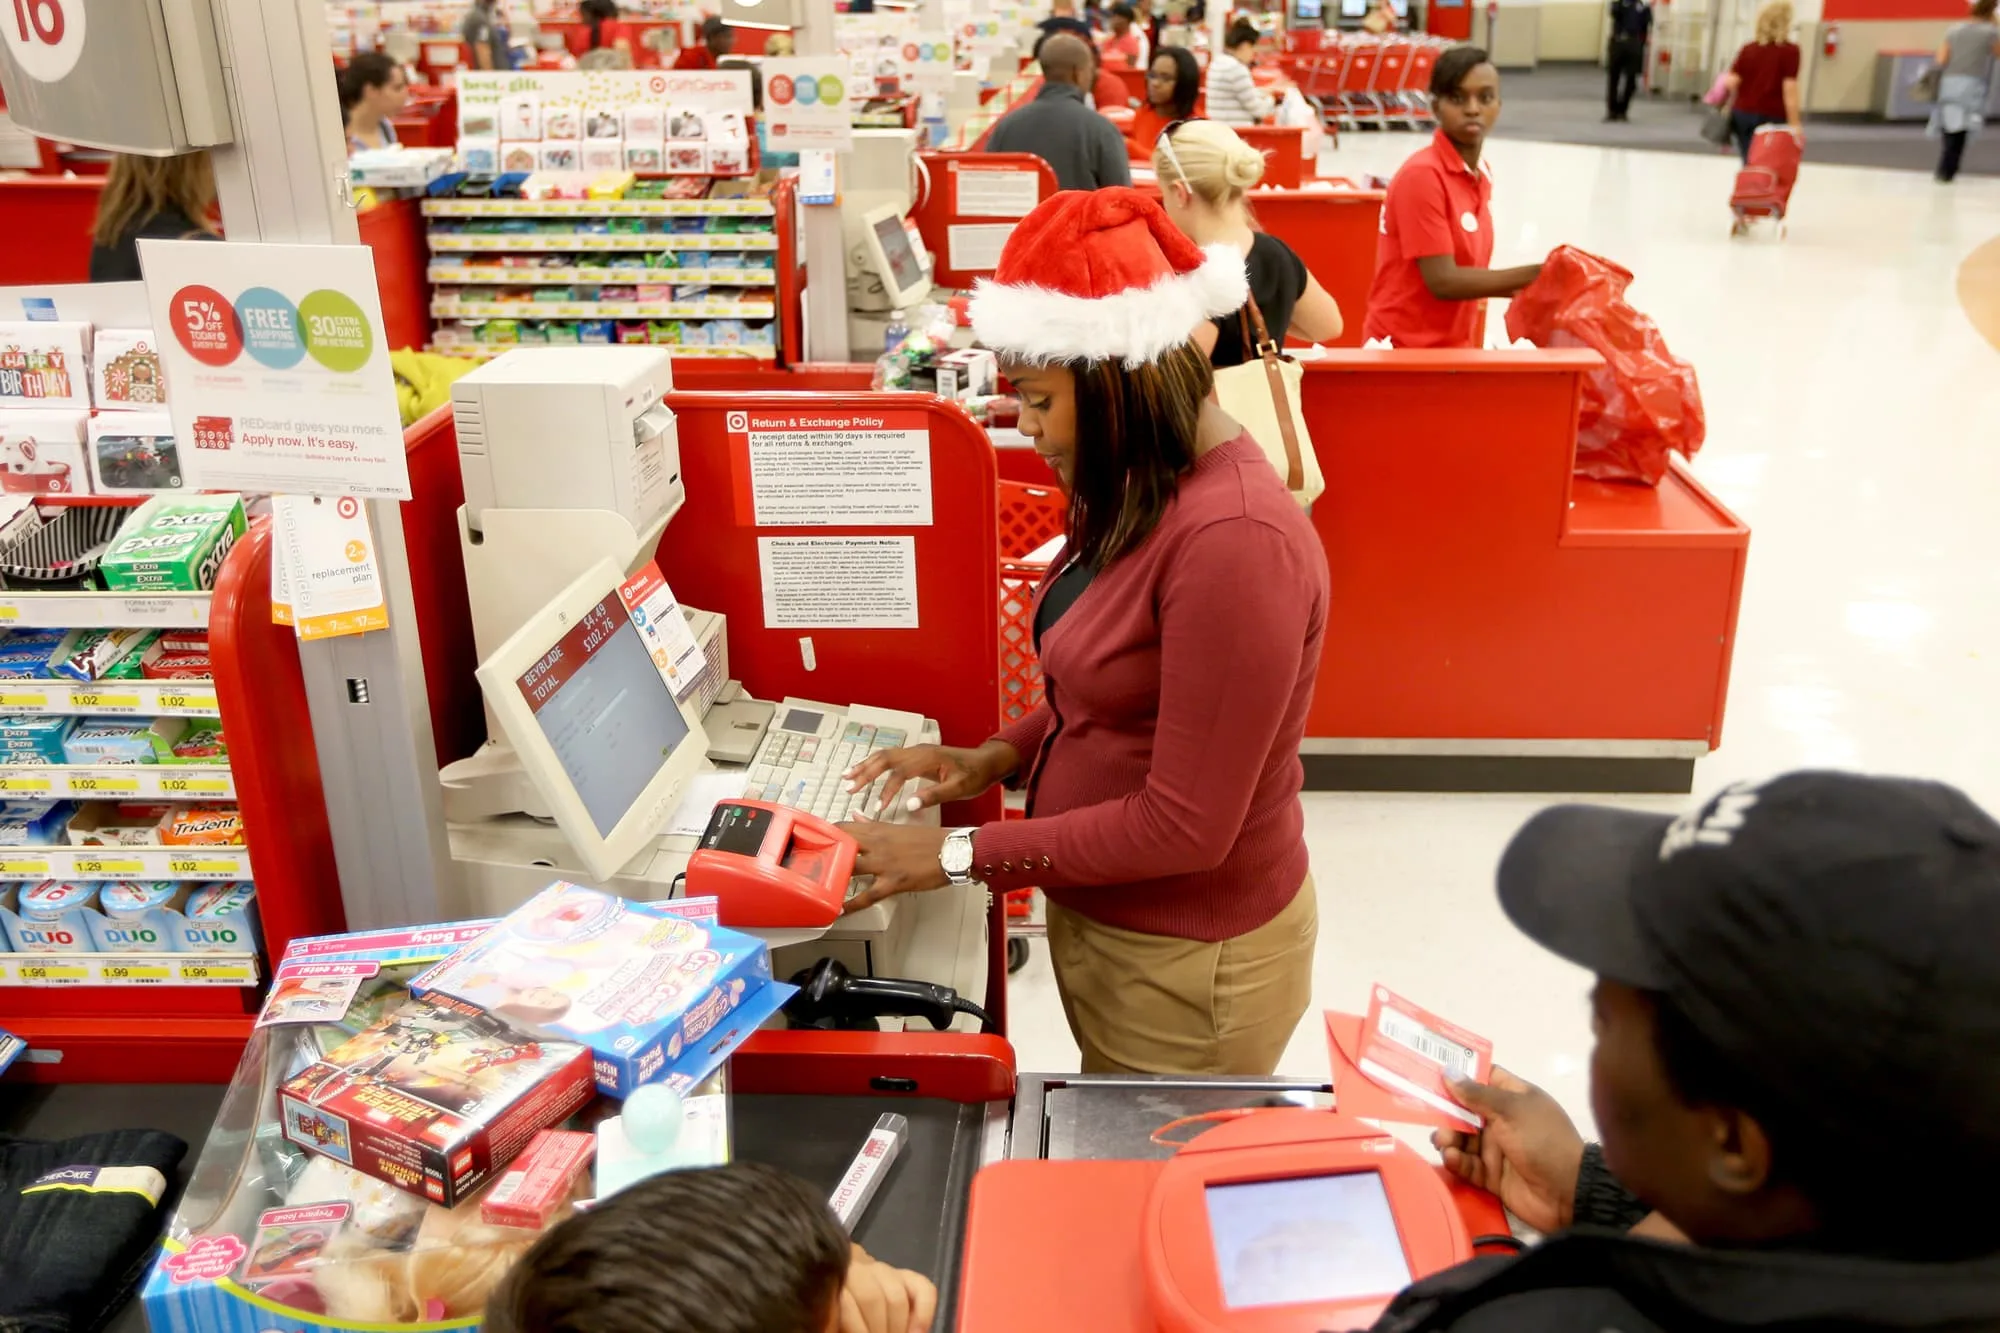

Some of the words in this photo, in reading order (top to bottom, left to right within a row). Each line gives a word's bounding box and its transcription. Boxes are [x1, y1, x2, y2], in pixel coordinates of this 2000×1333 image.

[13, 0, 65, 46] 16
[184, 300, 222, 332] 5%
[244, 308, 291, 330] FREE
[205, 321, 223, 331] OFF
[310, 315, 336, 337] 30
[337, 327, 362, 338] DAYS
[250, 329, 295, 342] SHIPPING
[5, 353, 62, 368] HAPPY
[240, 416, 292, 432] REDcard
[294, 420, 325, 434] gives
[328, 422, 349, 435] you
[352, 425, 387, 436] more.
[751, 417, 786, 428] Return
[789, 417, 797, 427] &
[799, 417, 850, 429] Exchange
[852, 417, 884, 428] Policy
[242, 433, 274, 448] Apply
[277, 436, 305, 447] now.
[307, 436, 326, 448] It's
[328, 439, 359, 452] easy.
[760, 433, 785, 442] receipt
[810, 432, 833, 440] within
[845, 432, 864, 440] days
[874, 432, 906, 440] required
[150, 511, 228, 528] Extra
[115, 532, 198, 554] Extra
[311, 563, 372, 582] replacement
[352, 573, 373, 584] plan
[524, 645, 564, 687] BEYBLADE
[583, 603, 607, 630] $4.49
[532, 674, 560, 701] TOTAL
[583, 617, 614, 653] $102.76
[72, 696, 99, 706] 1.02
[160, 697, 186, 707] 1.02
[71, 780, 97, 790] 1.02
[162, 780, 189, 790] 1.02
[173, 817, 237, 836] Trident
[77, 862, 102, 872] 1.29
[171, 862, 198, 872] 1.02
[19, 930, 74, 945] DUO
[104, 929, 157, 943] DUO
[184, 929, 238, 943] DUO
[411, 926, 456, 945] Baby
[20, 967, 46, 978] 1.99
[103, 967, 129, 978] 1.99
[183, 967, 208, 978] 1.99
[333, 964, 358, 975] She
[847, 1162, 870, 1187] now.
